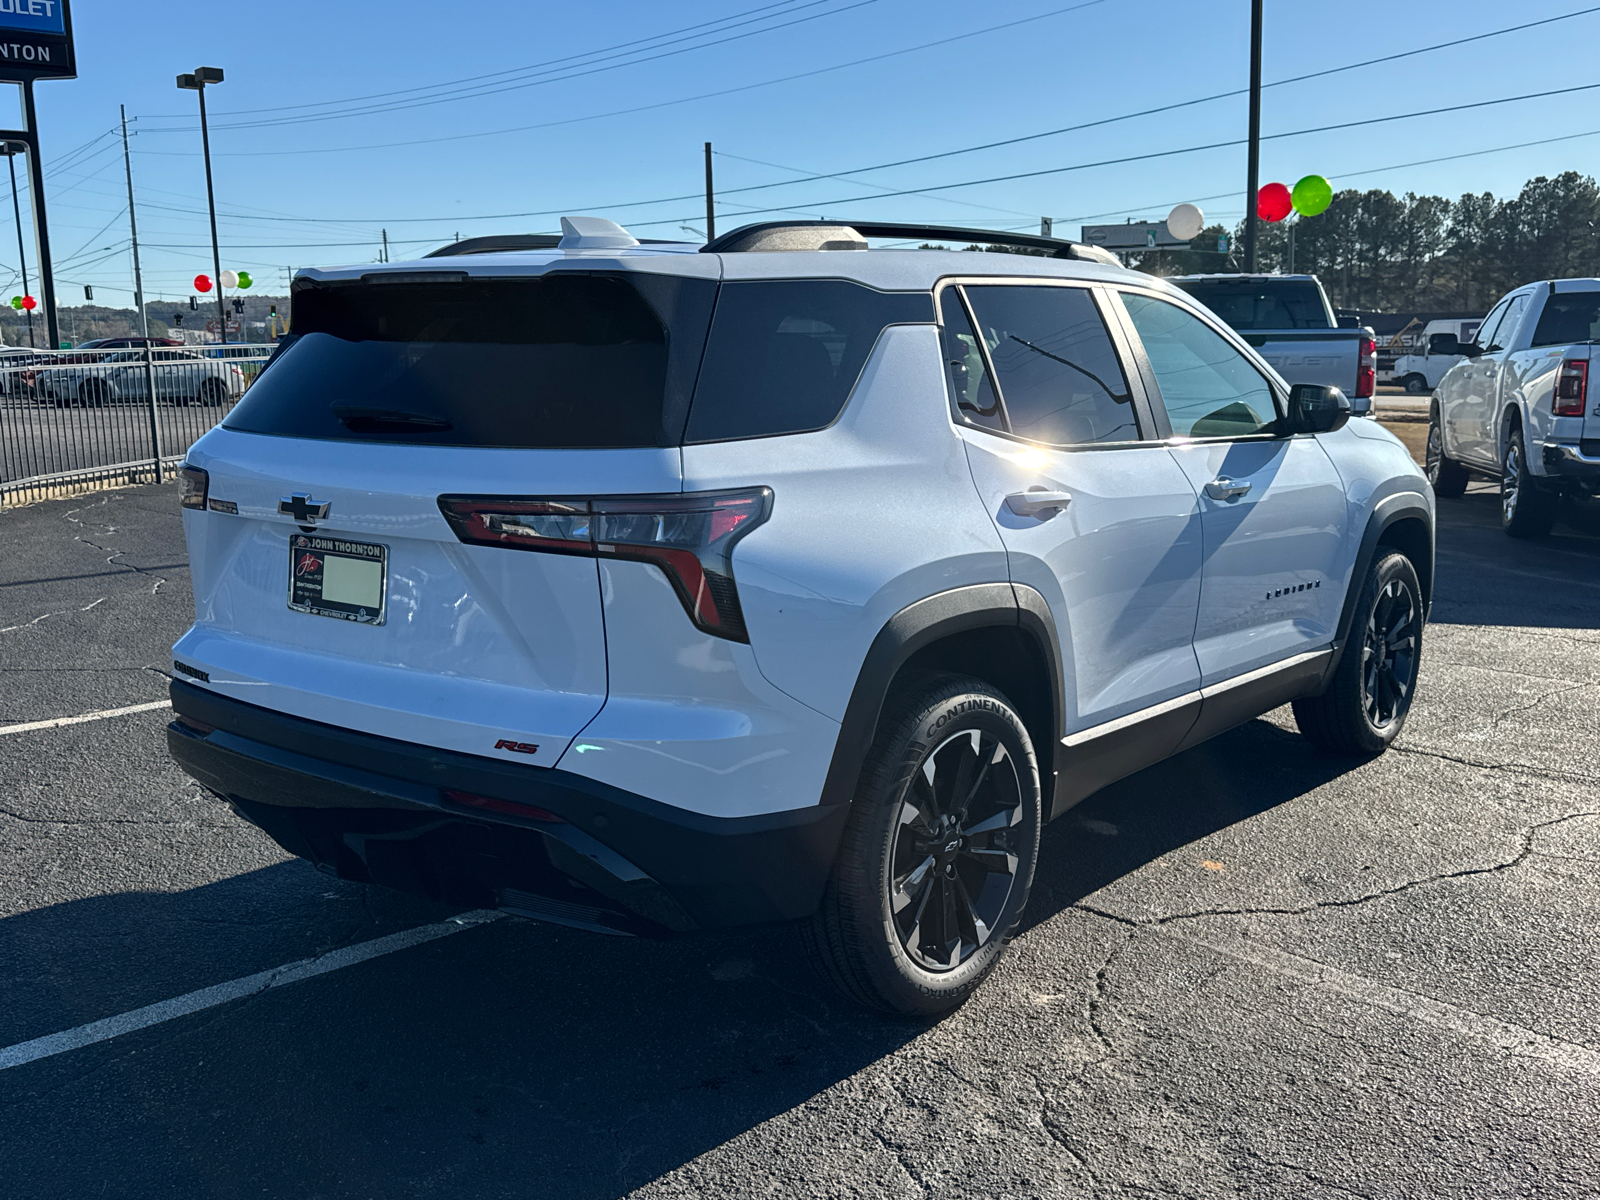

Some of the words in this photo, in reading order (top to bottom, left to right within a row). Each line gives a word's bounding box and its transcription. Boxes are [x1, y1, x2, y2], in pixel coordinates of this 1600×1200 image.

[312, 539, 333, 550] JOHN
[335, 542, 380, 556] THORNTON
[494, 738, 540, 754] RS
